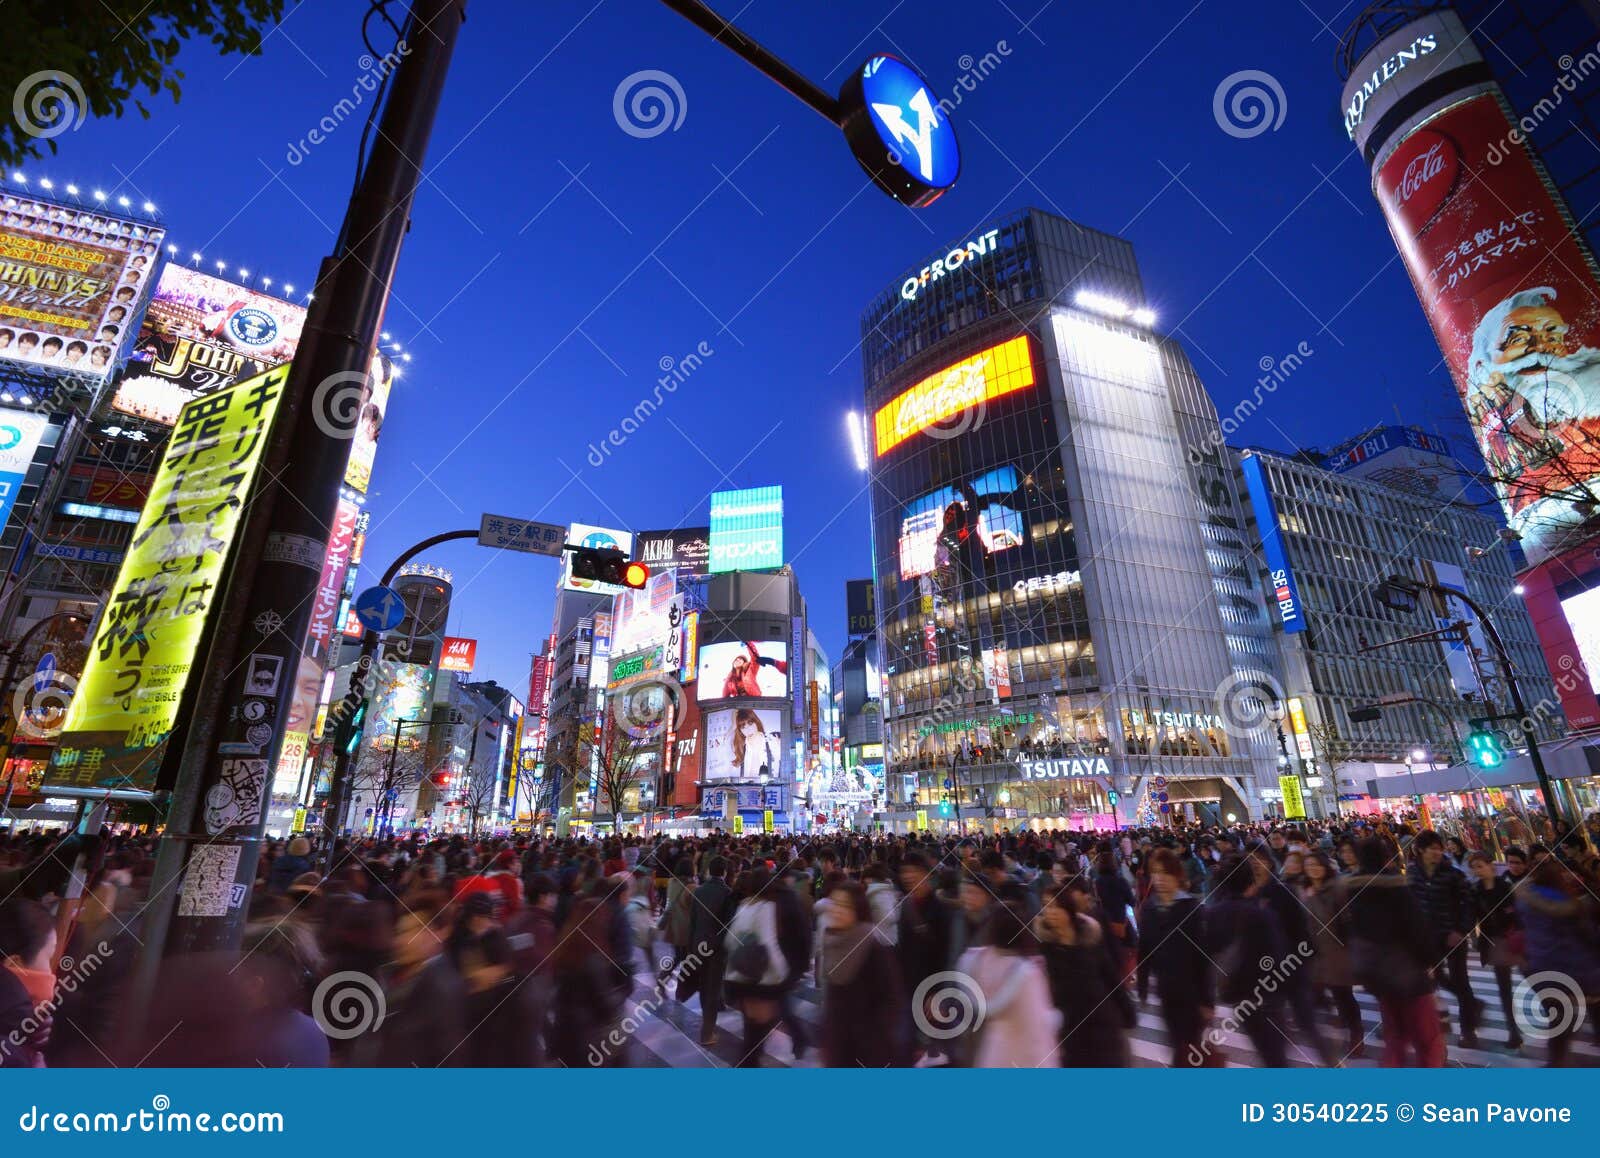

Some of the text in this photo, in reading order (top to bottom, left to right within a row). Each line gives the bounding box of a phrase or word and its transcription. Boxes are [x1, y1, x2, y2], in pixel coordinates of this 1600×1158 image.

[901, 229, 999, 300] QFRONT
[488, 519, 558, 543] 渋谷駅前
[641, 539, 674, 561] AKB48
[1271, 569, 1297, 623] SEIBU
[665, 602, 682, 668] もんじゃ
[447, 641, 470, 656] H&M
[529, 657, 546, 710] Essential
[155, 691, 177, 703] BIBLE
[1153, 711, 1226, 729] TSUTAYA
[52, 747, 106, 783] 聖書
[1023, 757, 1110, 779] TSUTAYA
